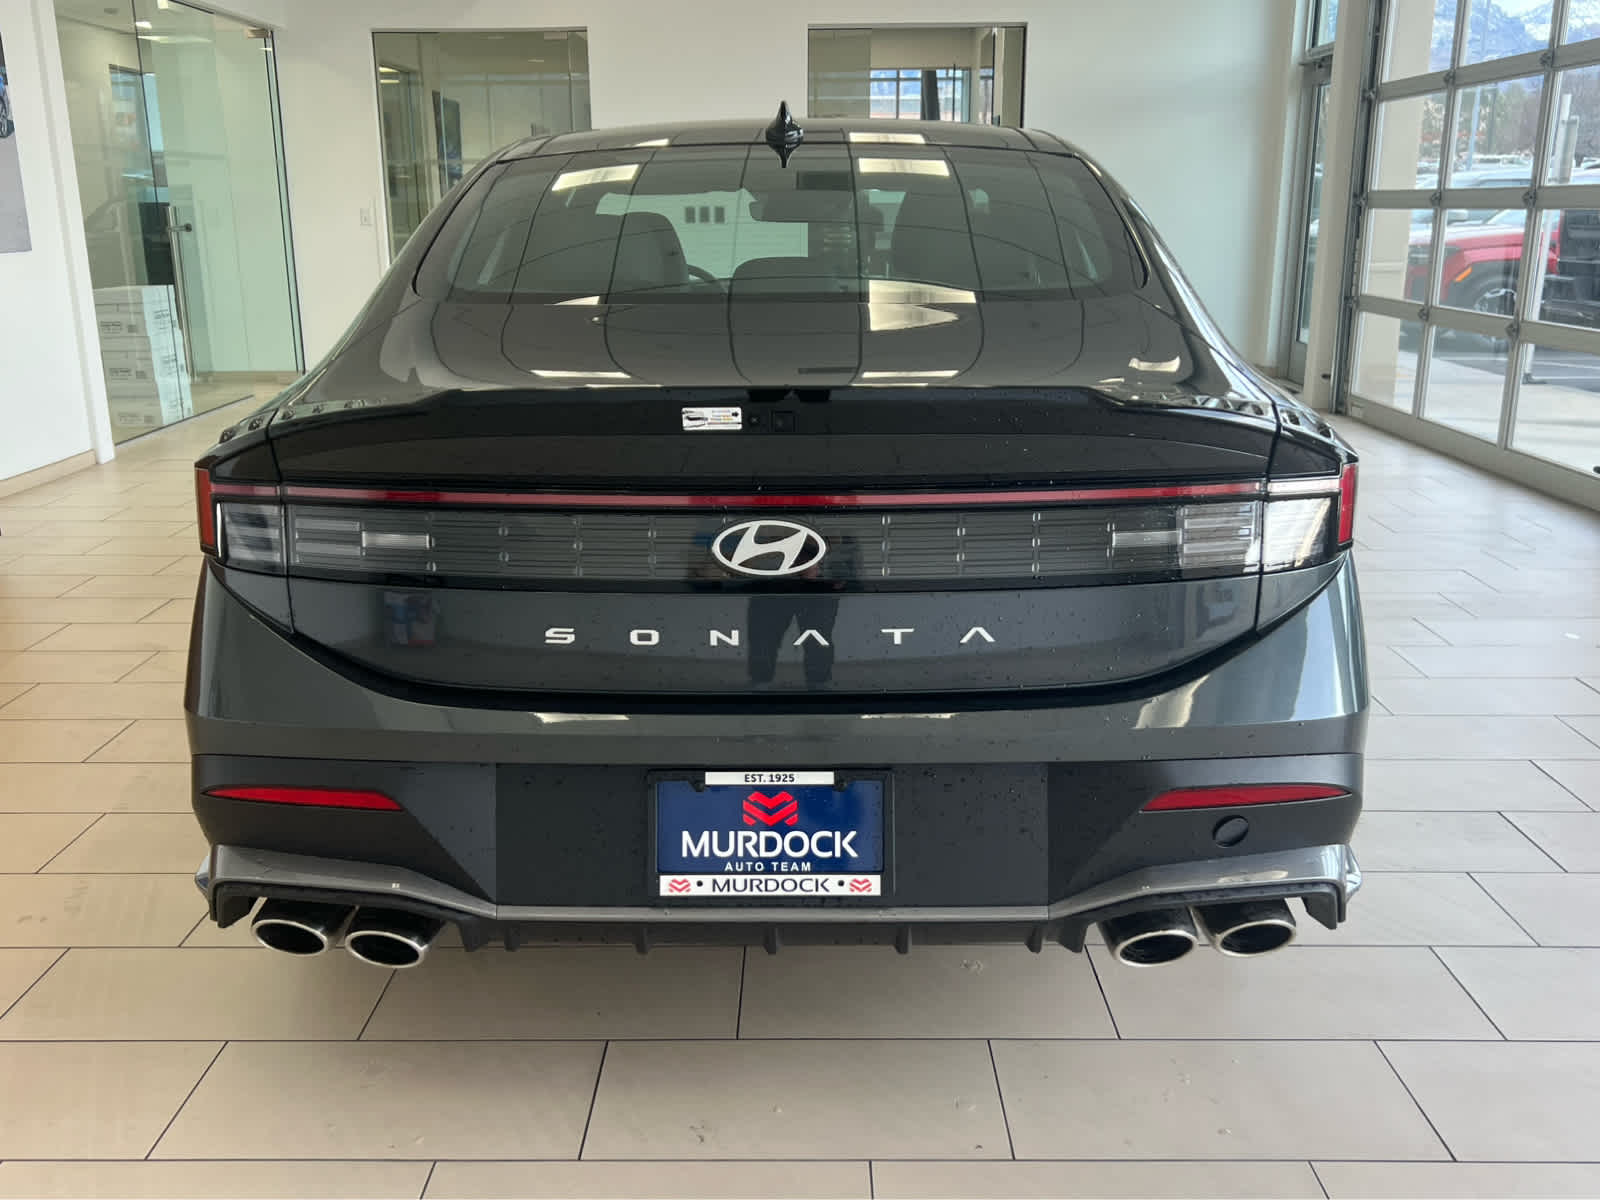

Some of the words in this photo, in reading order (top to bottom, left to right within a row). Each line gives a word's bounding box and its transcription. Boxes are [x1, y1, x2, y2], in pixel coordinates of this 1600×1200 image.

[544, 626, 996, 647] SONATA
[744, 773, 767, 783] EST.
[769, 773, 796, 783] 1925
[681, 830, 859, 858] MURDOCK
[724, 862, 764, 872] AUTO
[771, 862, 812, 872] TEAM
[711, 878, 831, 893] MURDOCK
